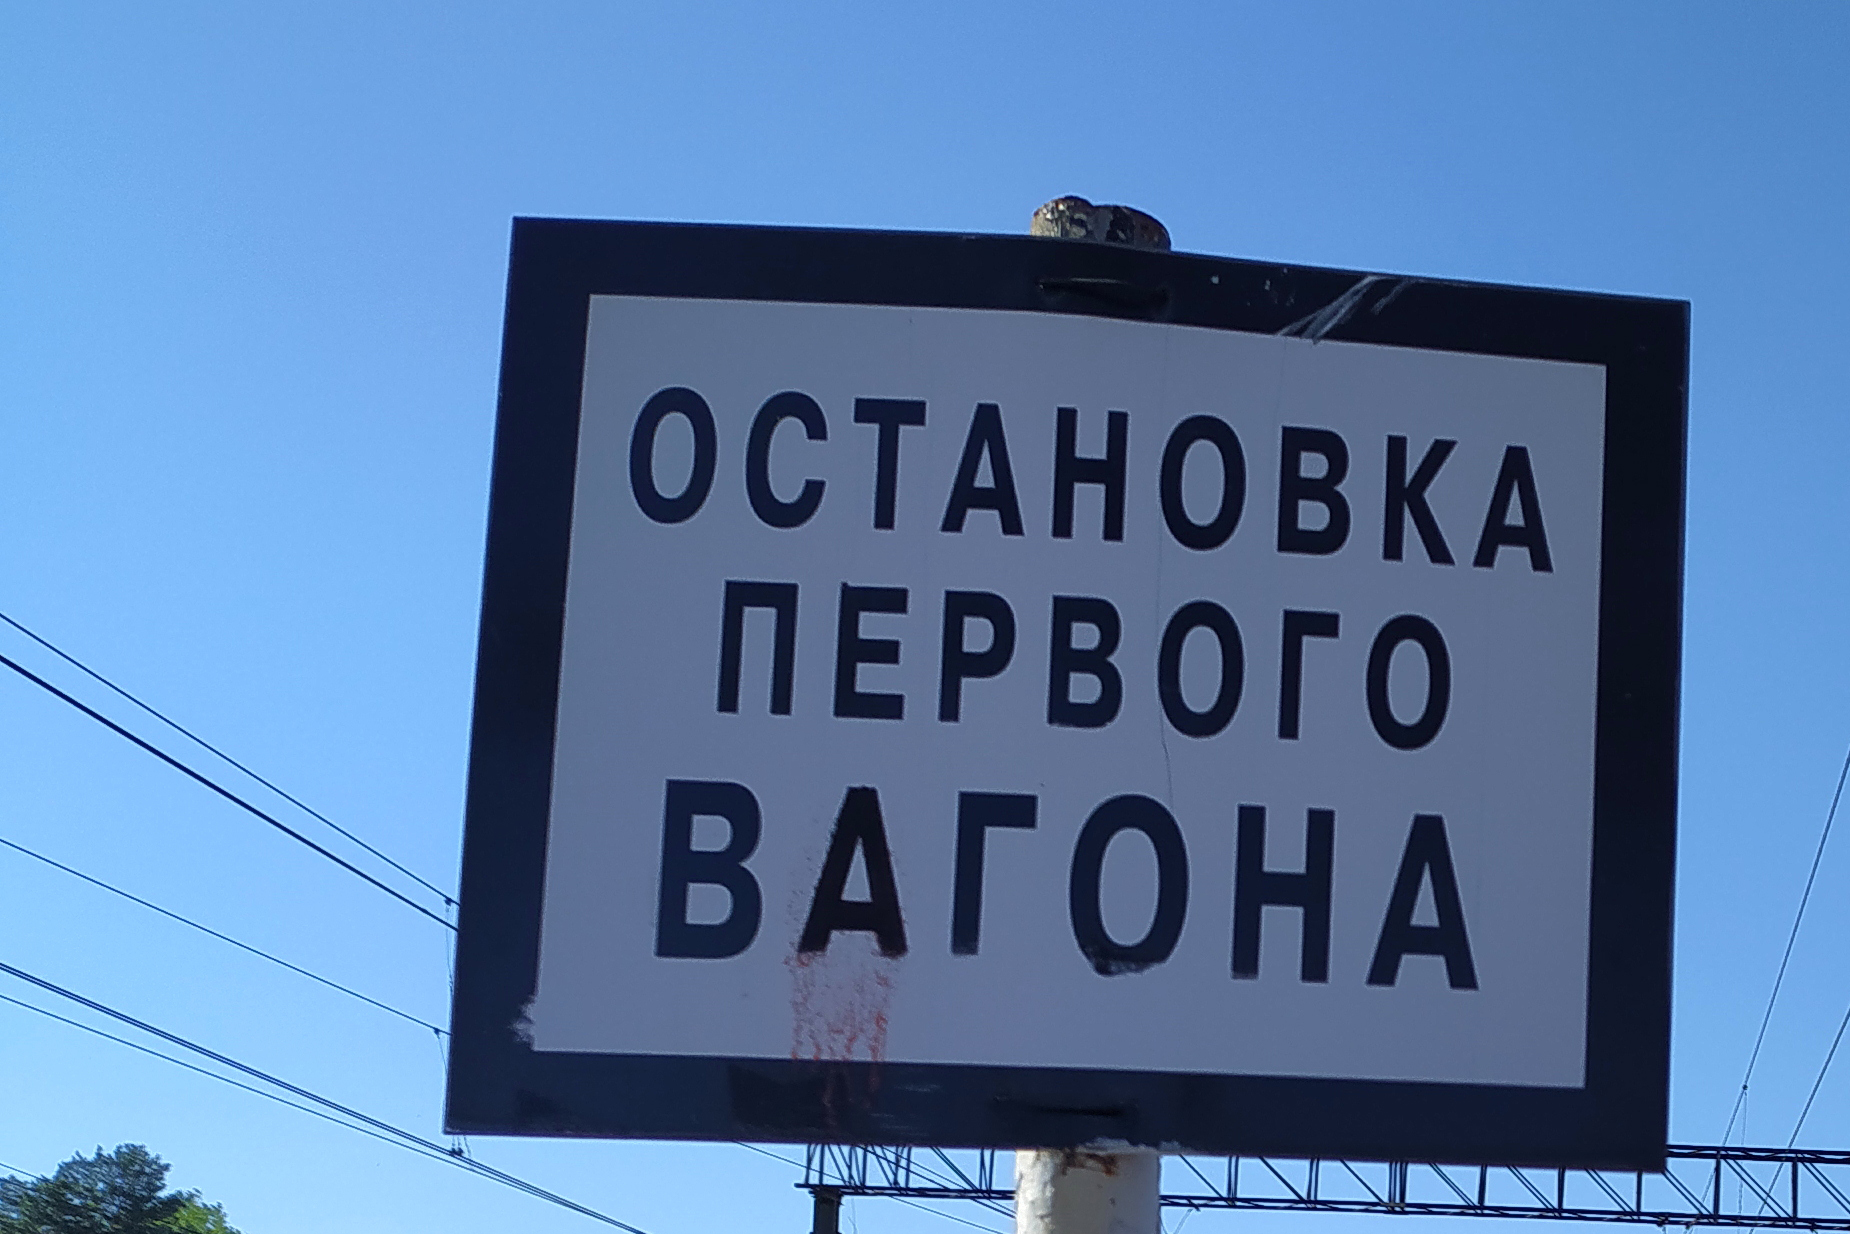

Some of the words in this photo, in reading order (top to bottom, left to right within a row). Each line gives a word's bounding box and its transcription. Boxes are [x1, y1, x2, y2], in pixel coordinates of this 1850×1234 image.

[628, 386, 1554, 574] ОСТАНОВКА
[716, 579, 1451, 751] ПЕРВОГО
[654, 778, 1479, 992] ВАГОНА
